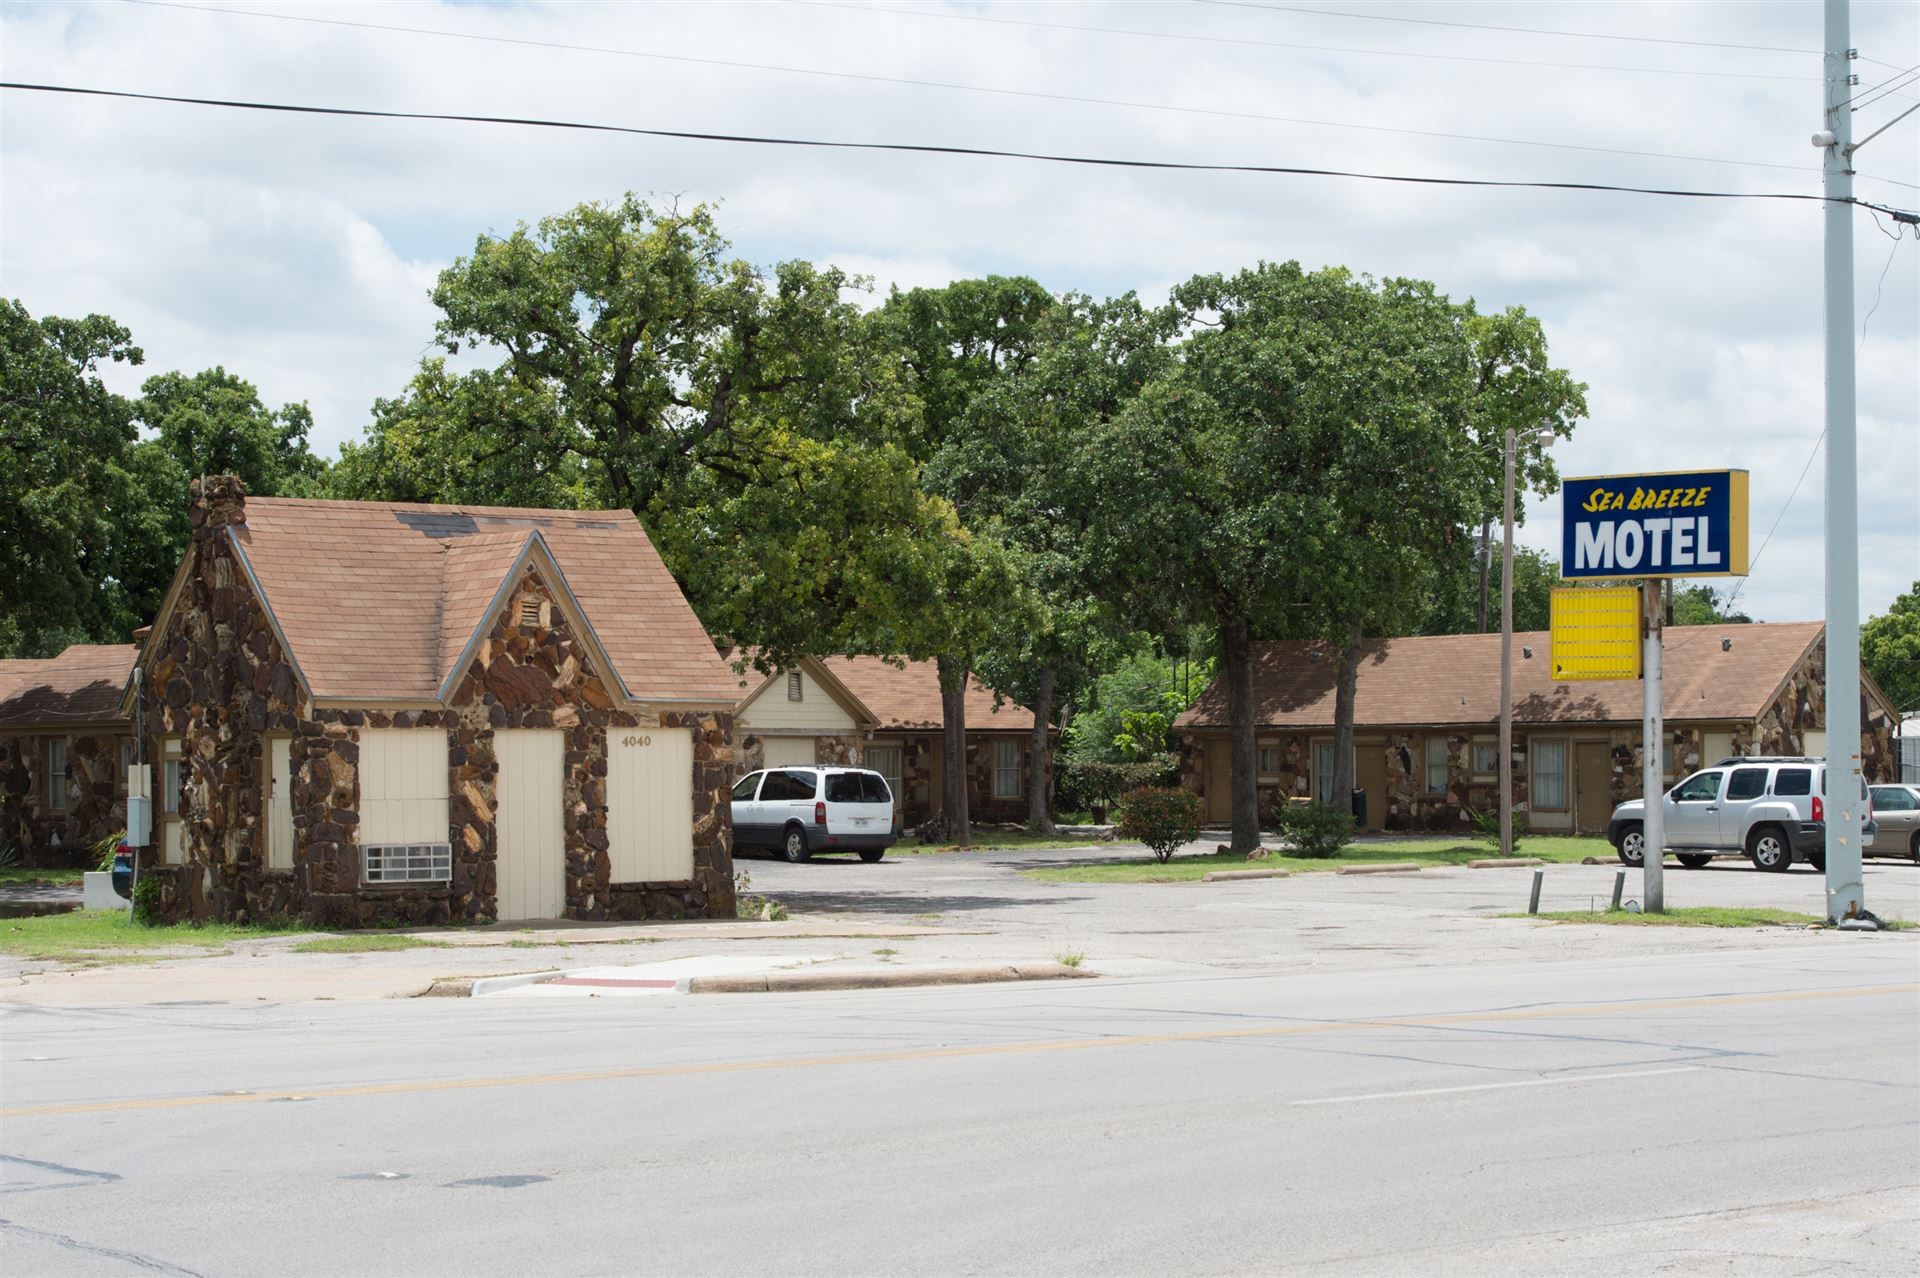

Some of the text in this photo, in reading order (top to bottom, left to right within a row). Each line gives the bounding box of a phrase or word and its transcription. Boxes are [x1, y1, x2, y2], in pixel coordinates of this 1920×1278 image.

[1582, 487, 1712, 512] SEA BREEZE
[1574, 516, 1721, 569] MOTEL
[622, 735, 652, 747] 4040
